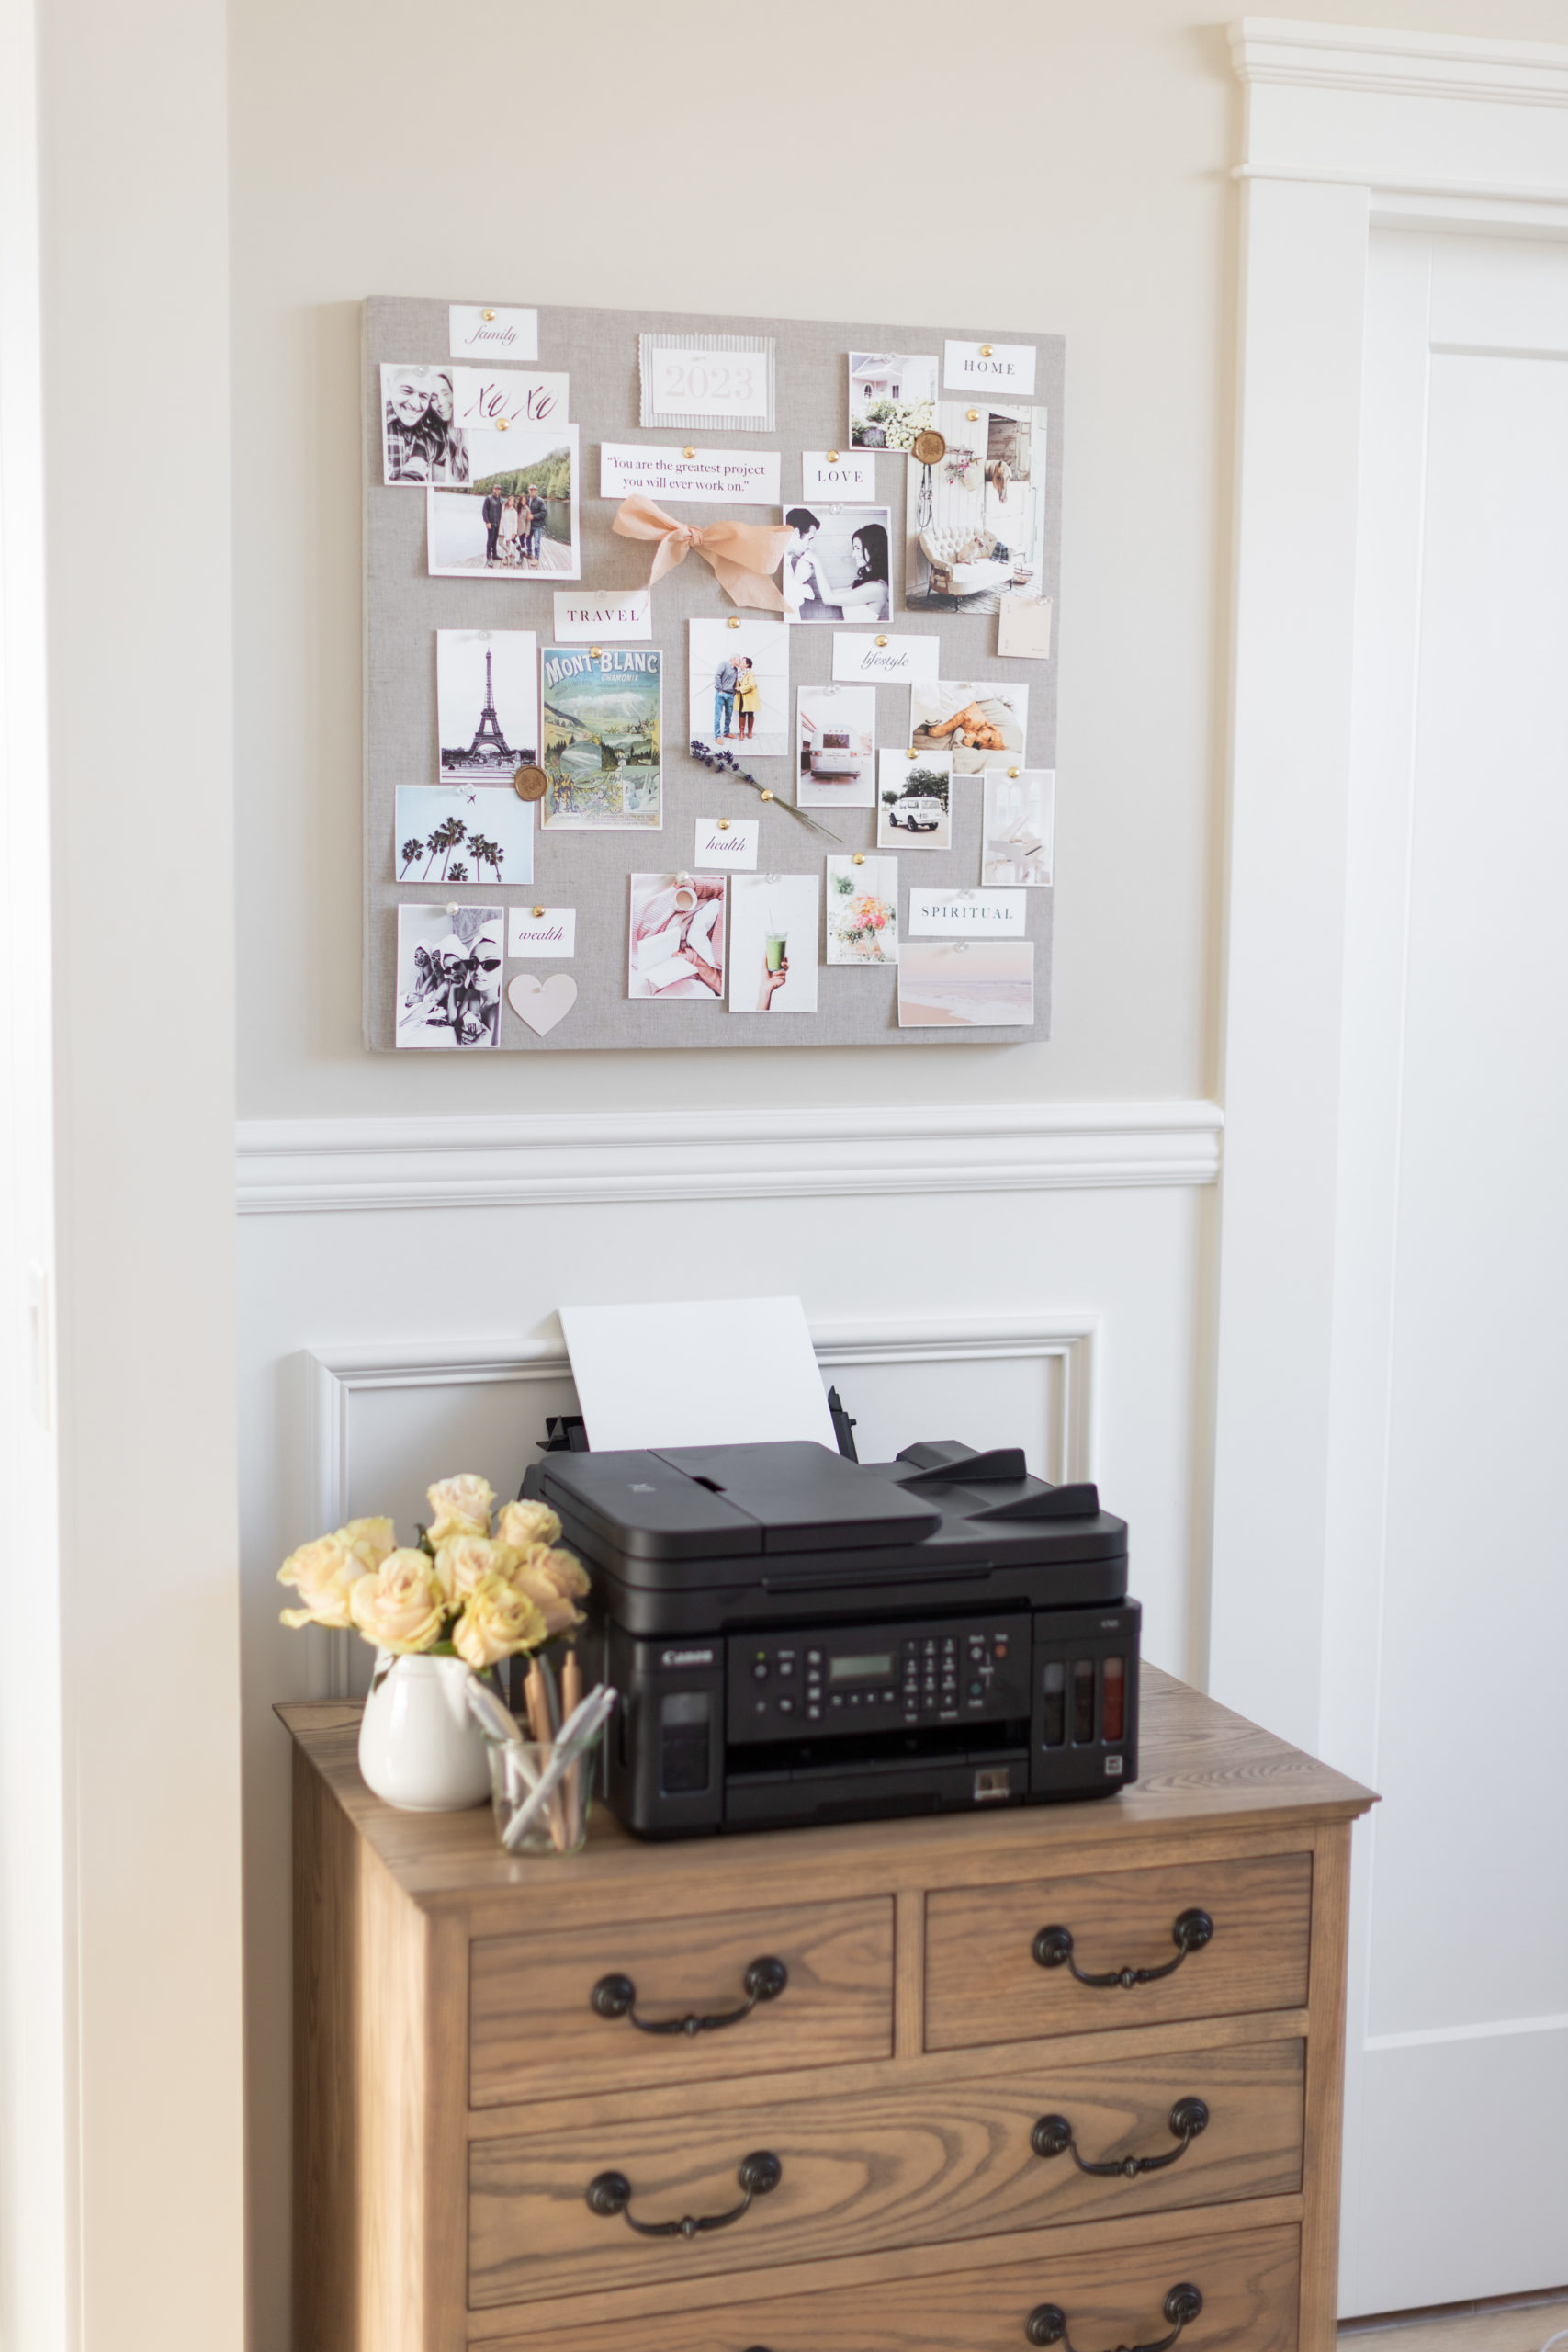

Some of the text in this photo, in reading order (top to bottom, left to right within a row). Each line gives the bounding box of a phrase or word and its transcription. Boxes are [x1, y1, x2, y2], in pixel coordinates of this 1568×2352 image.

[464, 324, 519, 346] family
[964, 359, 1016, 376] HOME
[665, 365, 753, 401] 2023
[636, 461, 653, 470] are
[656, 460, 673, 471] the
[675, 462, 721, 474] greatest
[724, 463, 766, 478] project
[818, 469, 864, 483] LOVE
[623, 477, 644, 489] you
[647, 477, 666, 489] will
[669, 481, 694, 490] ever
[695, 480, 725, 492] work
[567, 609, 640, 622] TRAVEL
[860, 650, 910, 669] lifestyle
[545, 651, 659, 689] MONT-BLANC
[601, 673, 640, 683] CHAMONIX
[705, 837, 747, 853] health
[921, 906, 1013, 920] SPIRITUAL
[518, 926, 564, 943] wealth
